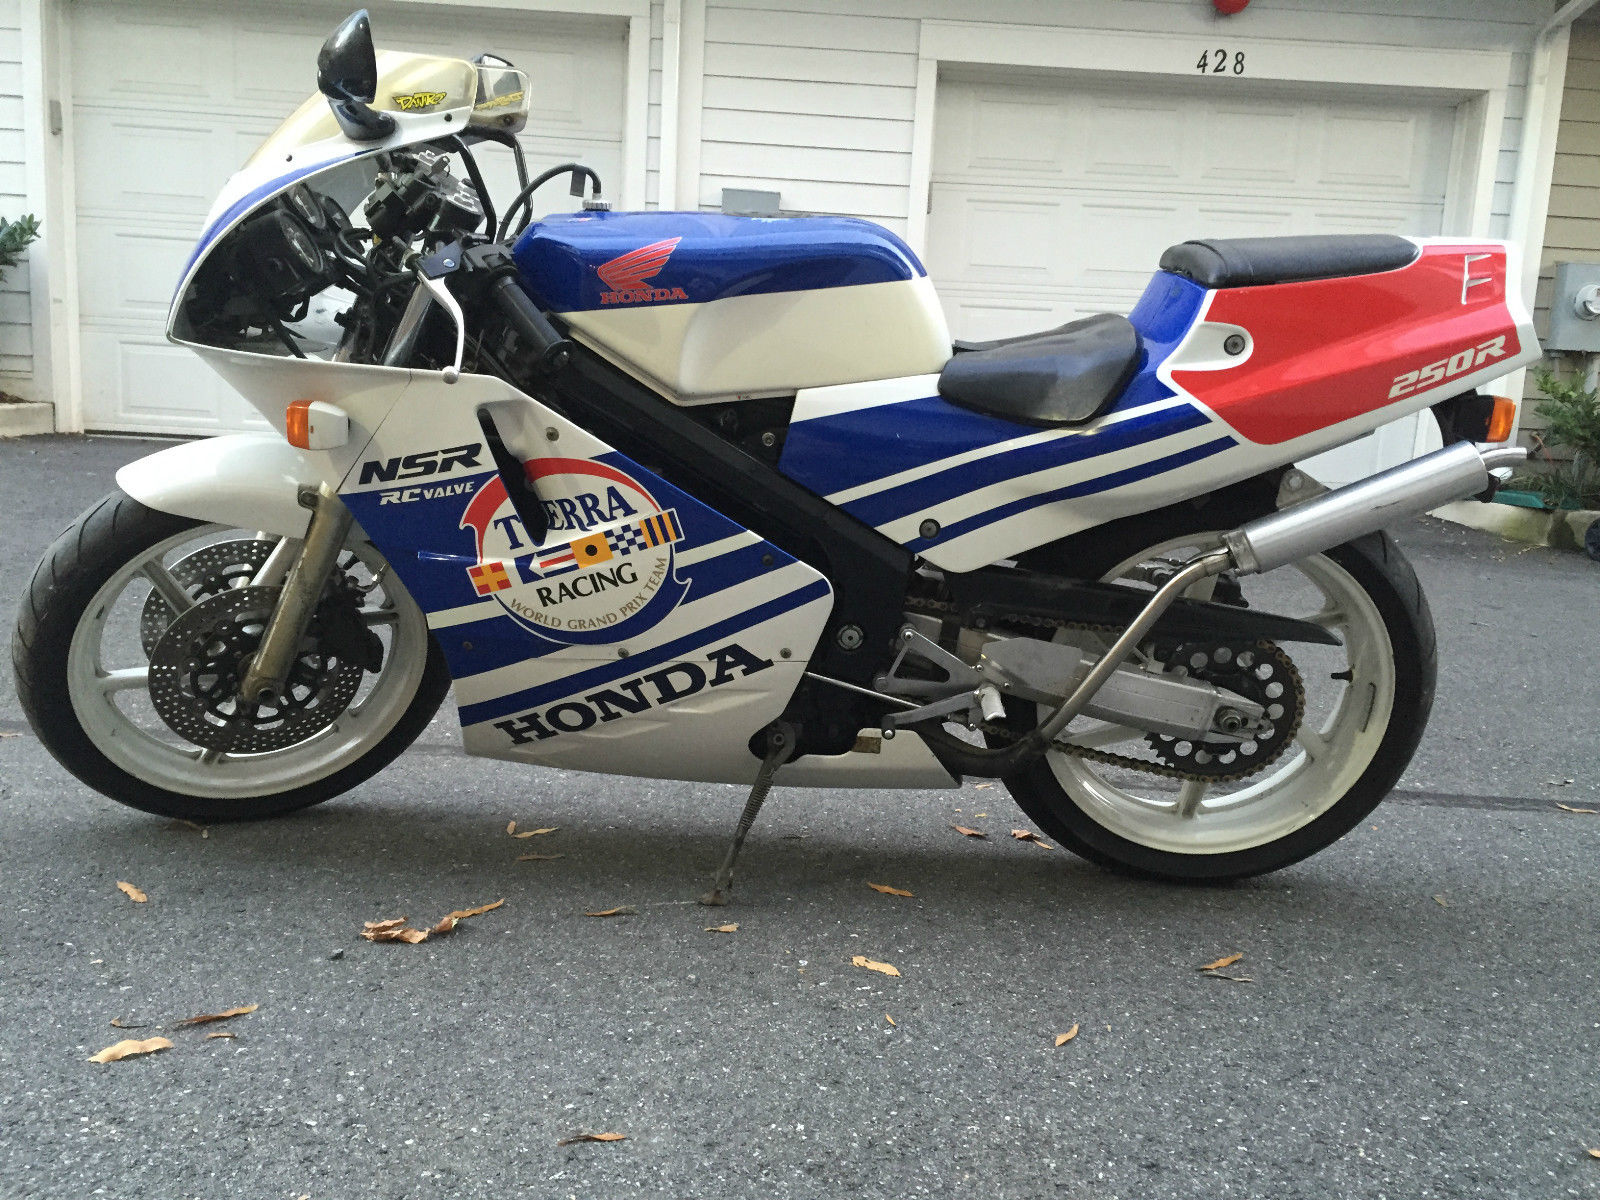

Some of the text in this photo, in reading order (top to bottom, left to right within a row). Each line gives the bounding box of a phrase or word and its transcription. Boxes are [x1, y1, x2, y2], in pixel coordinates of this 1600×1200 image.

[1196, 49, 1245, 75] 428
[600, 287, 689, 305] HONDA
[1387, 335, 1506, 399] 250R
[358, 442, 483, 485] NSR
[423, 481, 475, 501] VALVE
[510, 556, 668, 630] WORLD GRAND PRIX TEAM
[536, 562, 638, 607] RACING
[493, 643, 775, 745] HONDA
